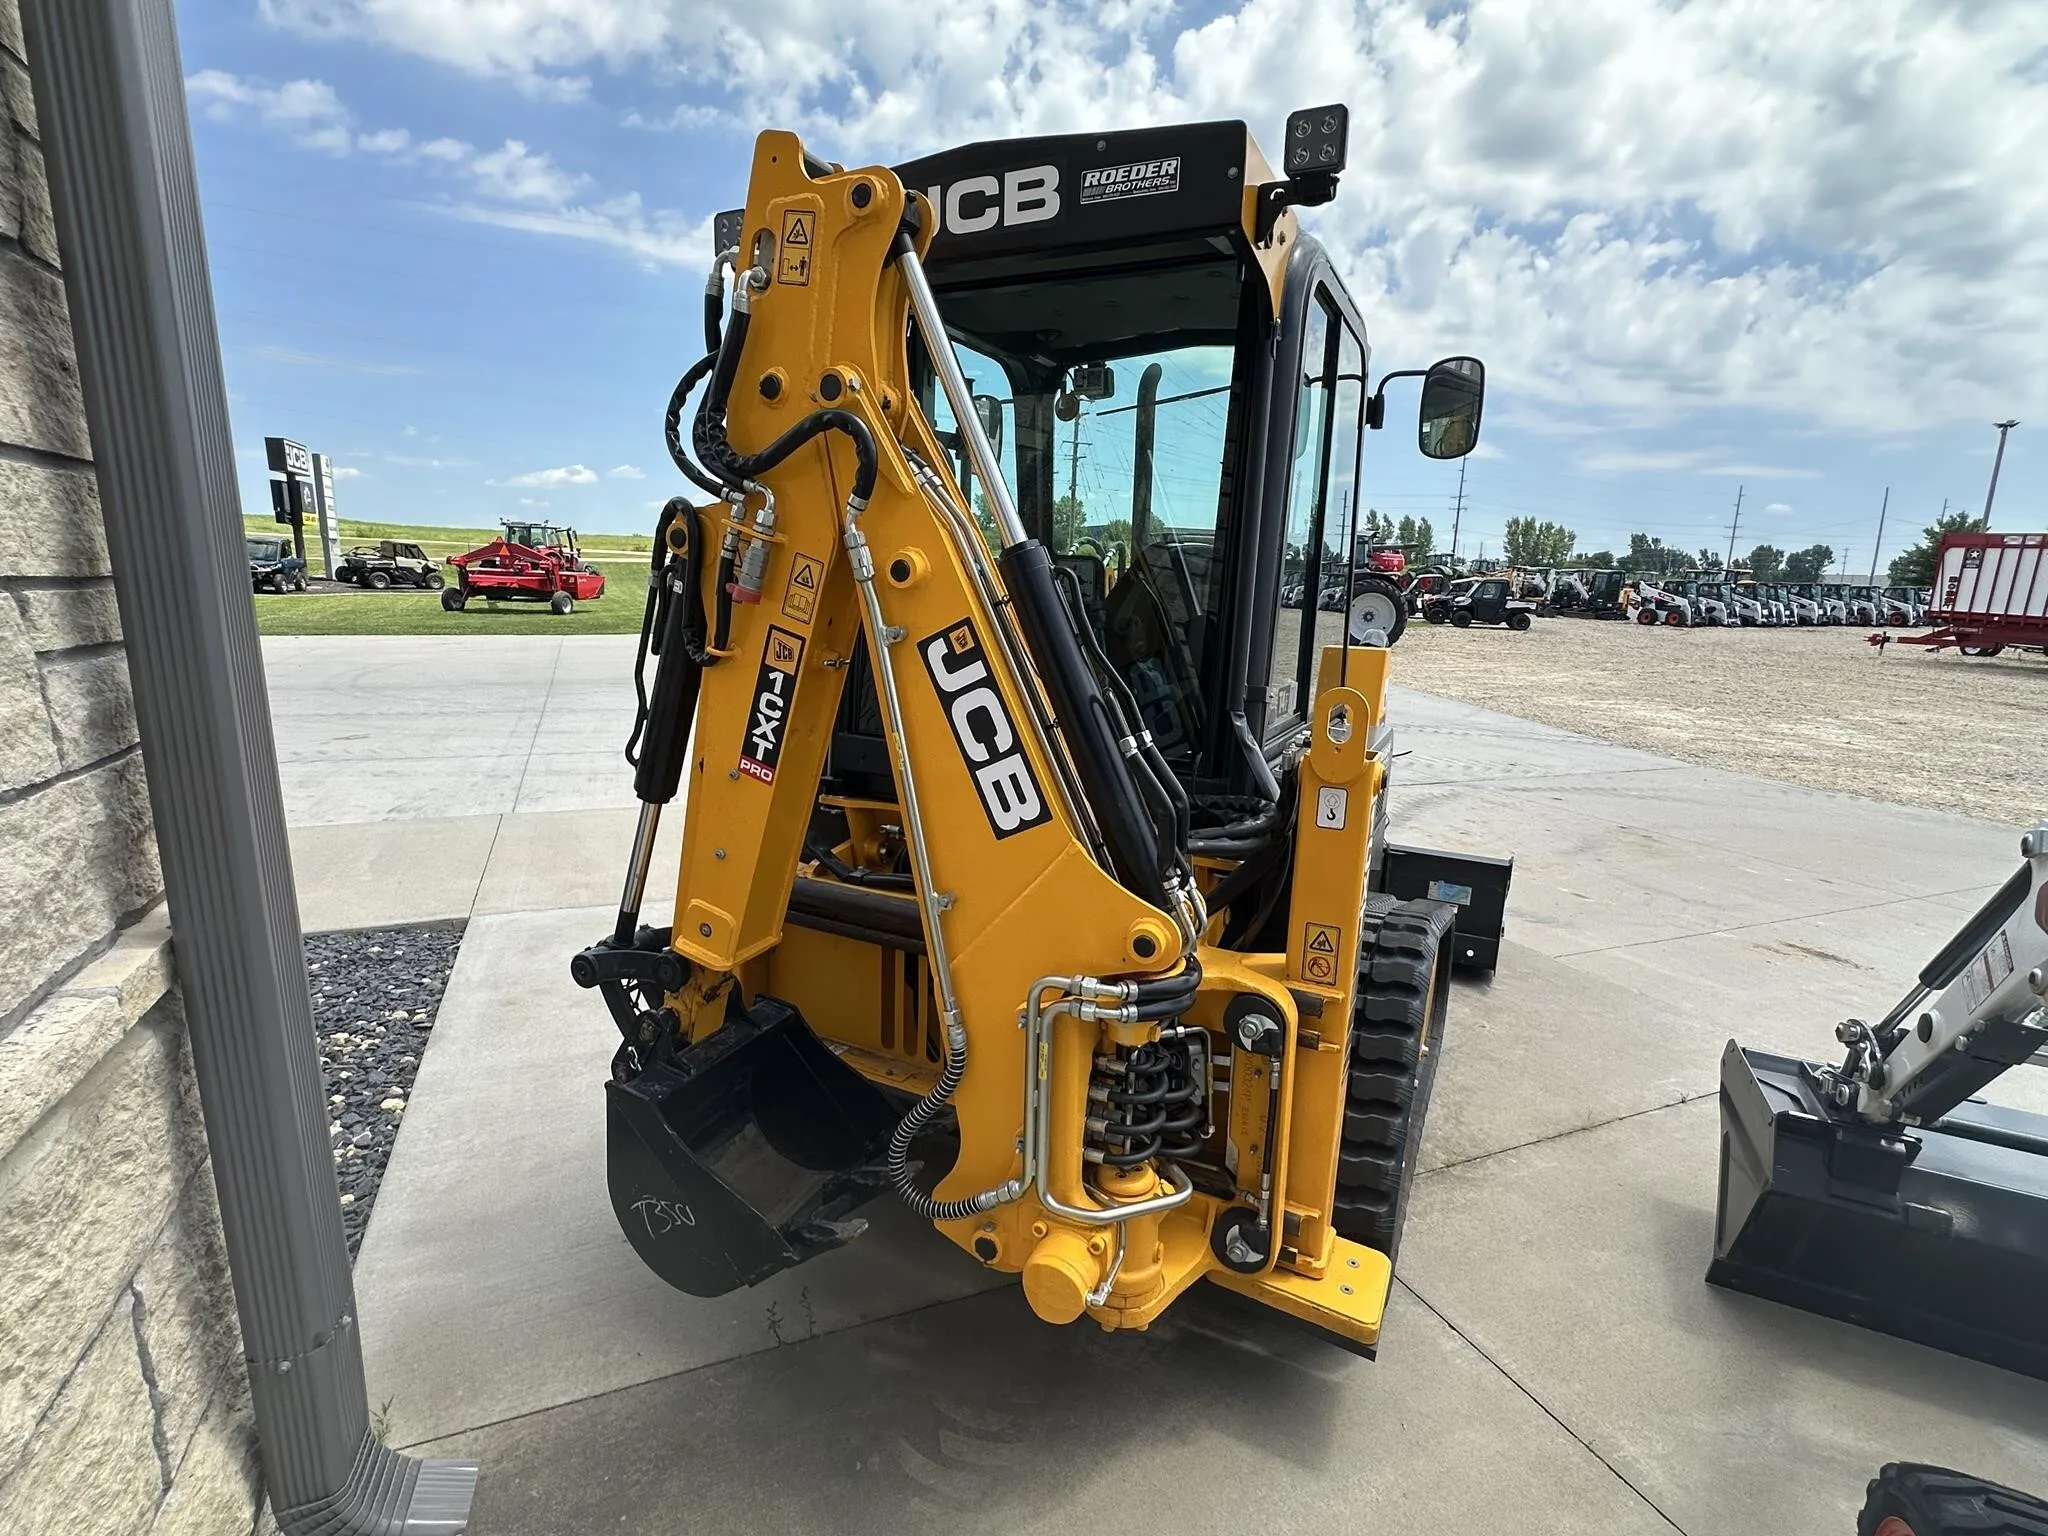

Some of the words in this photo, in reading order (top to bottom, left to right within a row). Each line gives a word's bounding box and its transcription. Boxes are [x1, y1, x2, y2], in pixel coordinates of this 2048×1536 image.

[1083, 159, 1178, 187] ROEDER
[1105, 176, 1171, 194] BROTHERS
[285, 442, 309, 472] JCB
[775, 640, 793, 660] JCB
[752, 671, 784, 761] 1CXT
[927, 637, 1041, 831] JCB
[739, 757, 773, 782] PRO
